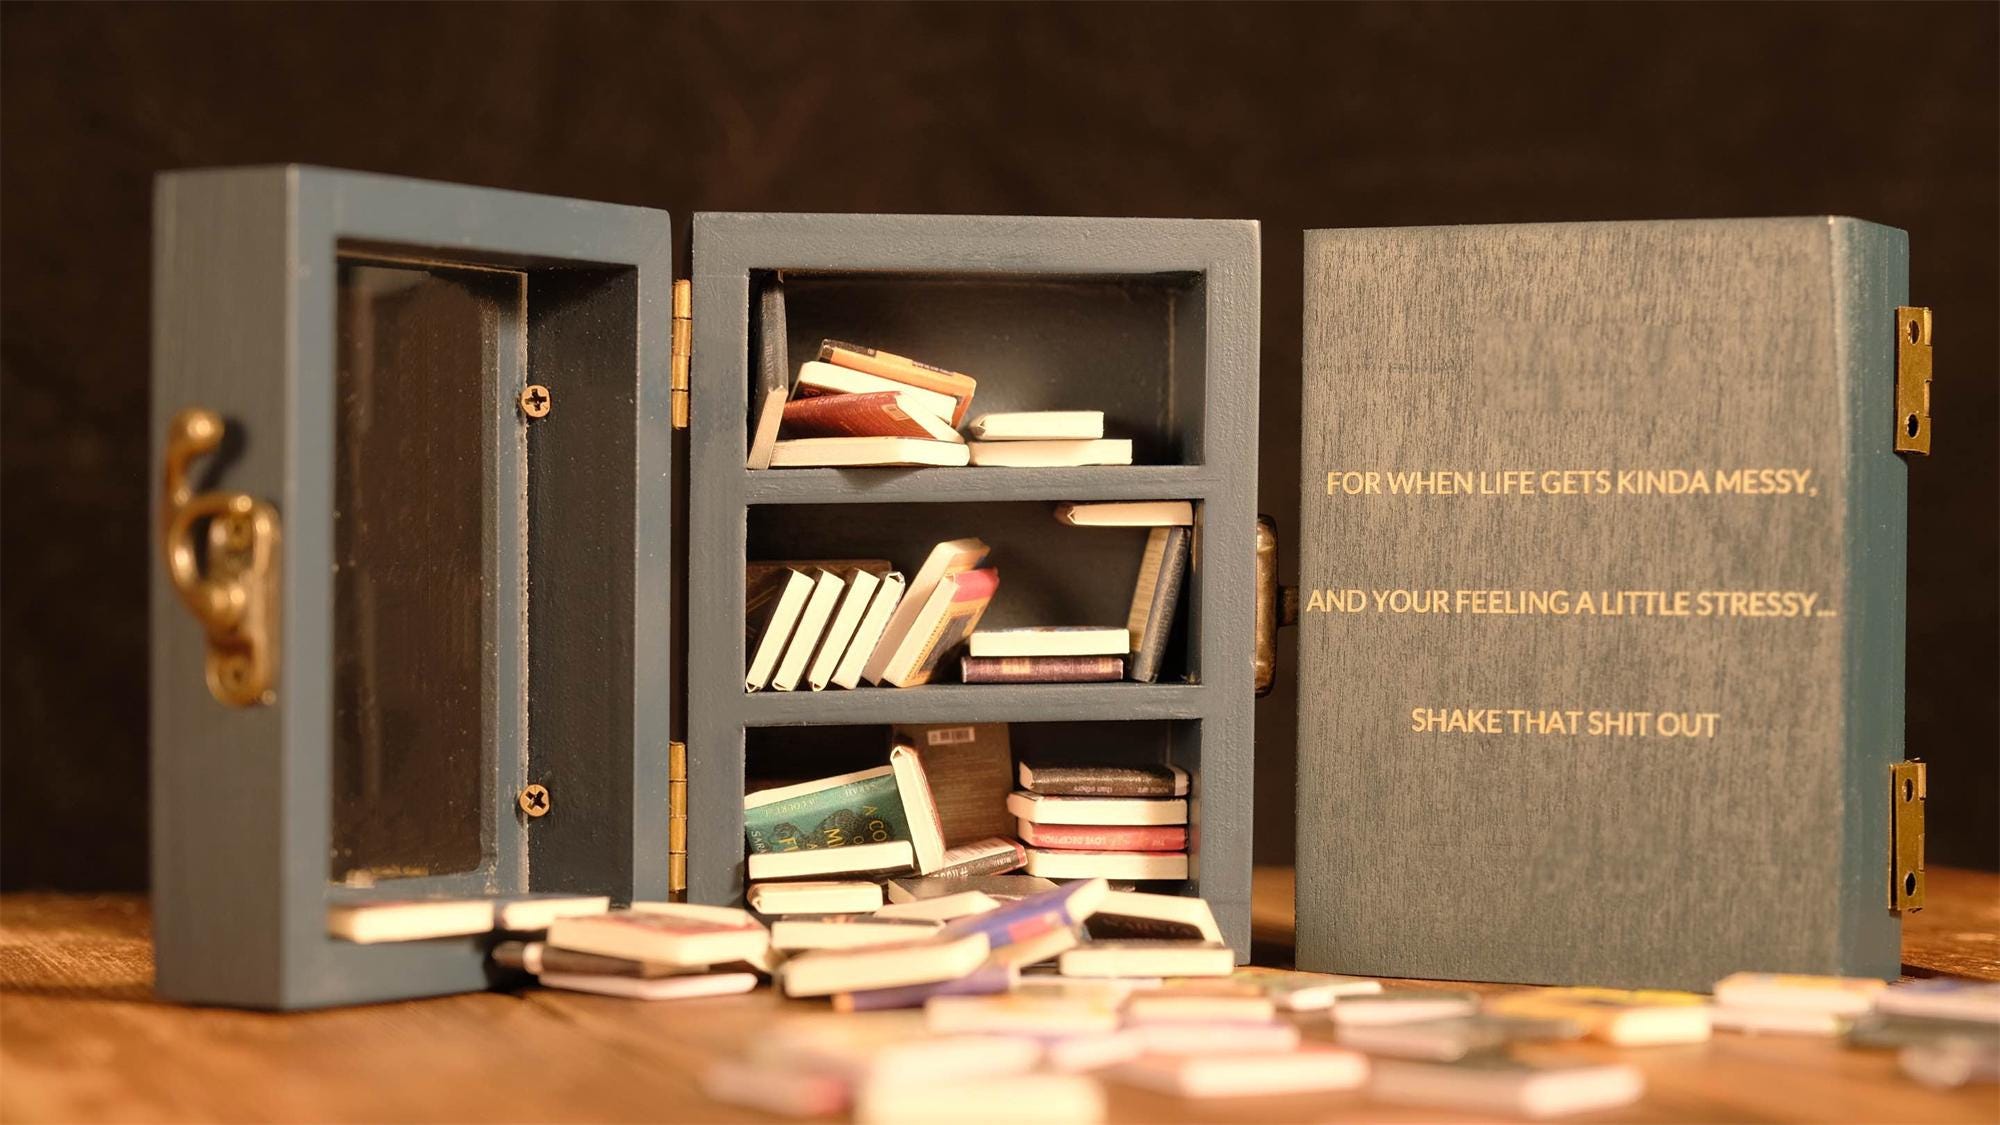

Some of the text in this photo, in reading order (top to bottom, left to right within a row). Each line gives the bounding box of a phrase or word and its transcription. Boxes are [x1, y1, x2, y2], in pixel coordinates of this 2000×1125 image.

[1327, 468, 1819, 497] FOR WHEN LIFE GETS KINDA MESSY,
[1306, 589, 1838, 617] AND YOUR FEELING A LITTLE STRESSY...
[1411, 707, 1720, 738] SHAKE THAT SHIT OUT
[751, 830, 768, 855] SARA
